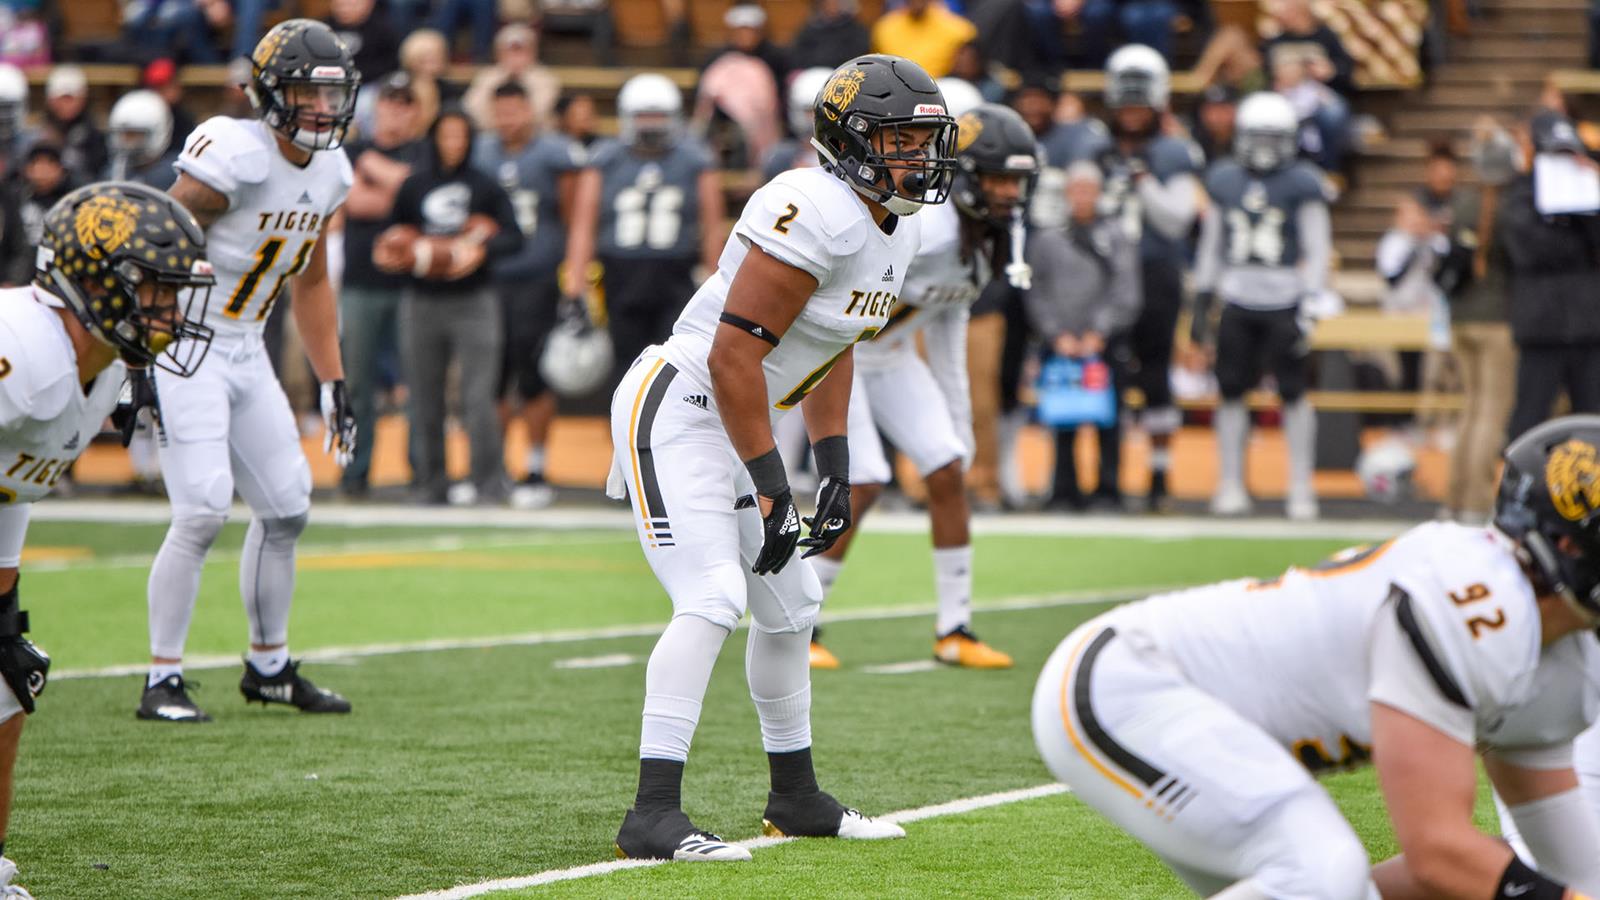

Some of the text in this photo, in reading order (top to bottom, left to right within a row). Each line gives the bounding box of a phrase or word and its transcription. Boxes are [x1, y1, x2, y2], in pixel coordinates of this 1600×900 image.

[188, 134, 213, 159] 11
[772, 203, 799, 235] 2
[779, 504, 794, 536] adidas
[1446, 583, 1506, 640] 92
